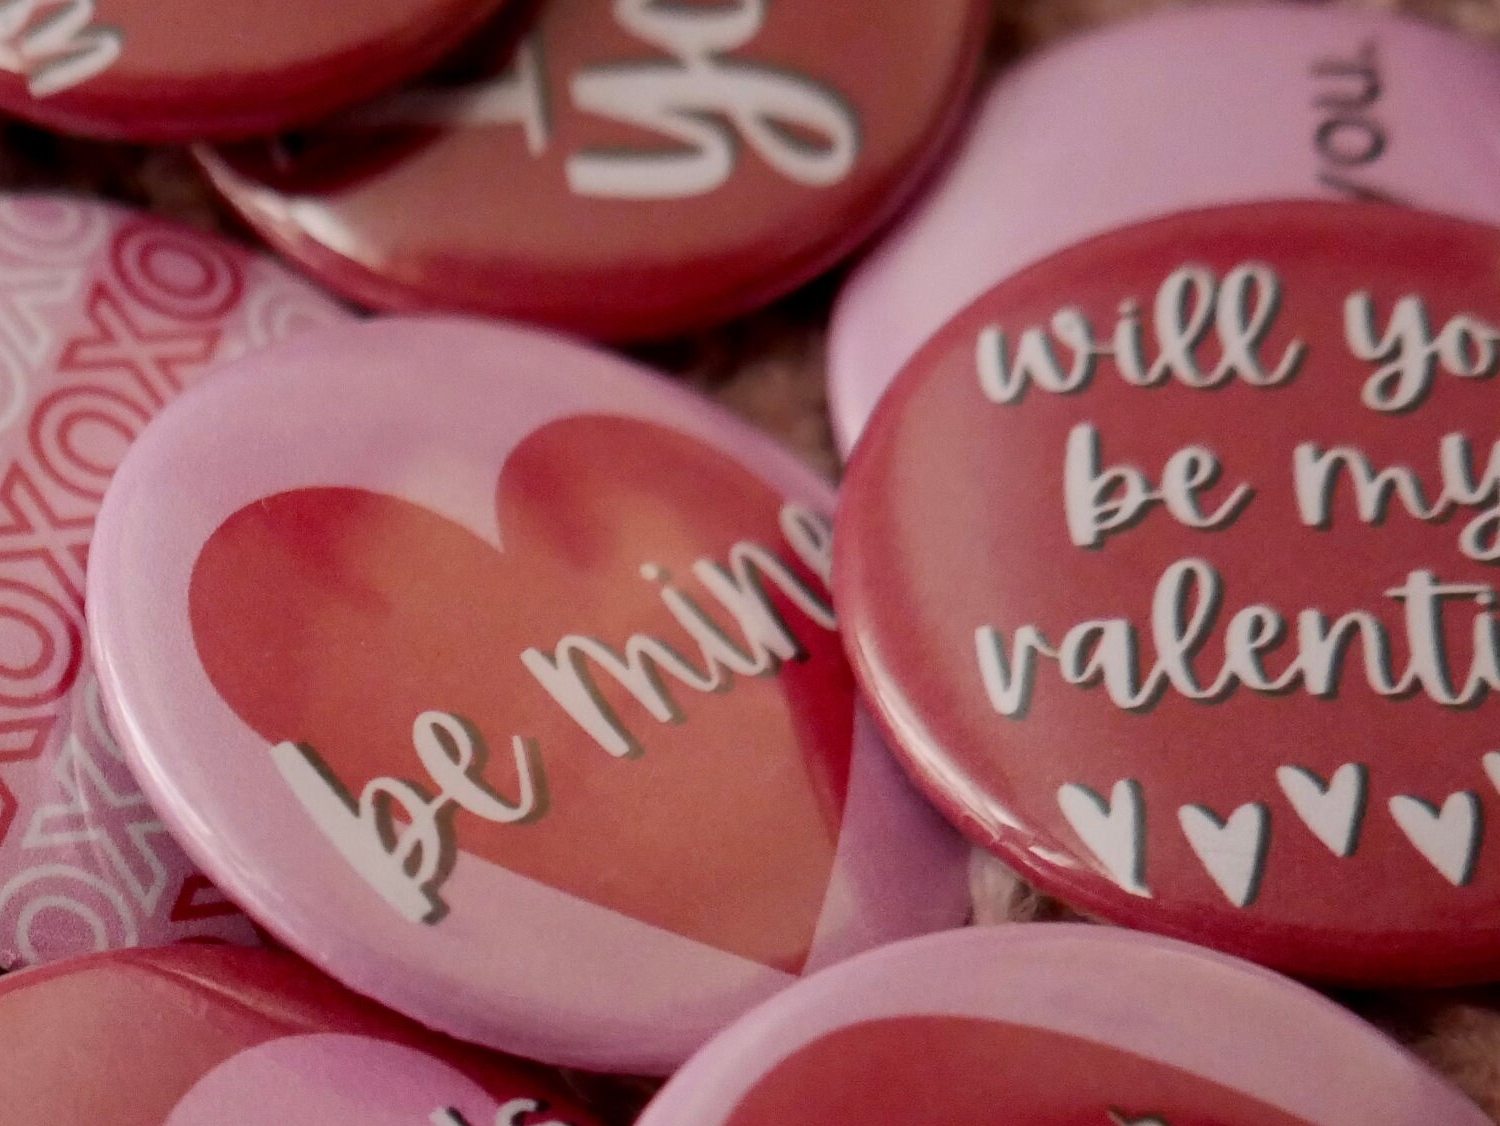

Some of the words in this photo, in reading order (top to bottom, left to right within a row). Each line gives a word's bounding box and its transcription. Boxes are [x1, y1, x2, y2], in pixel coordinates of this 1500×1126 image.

[975, 261, 1308, 405] will
[1063, 421, 1256, 551] be
[270, 709, 550, 926] be
